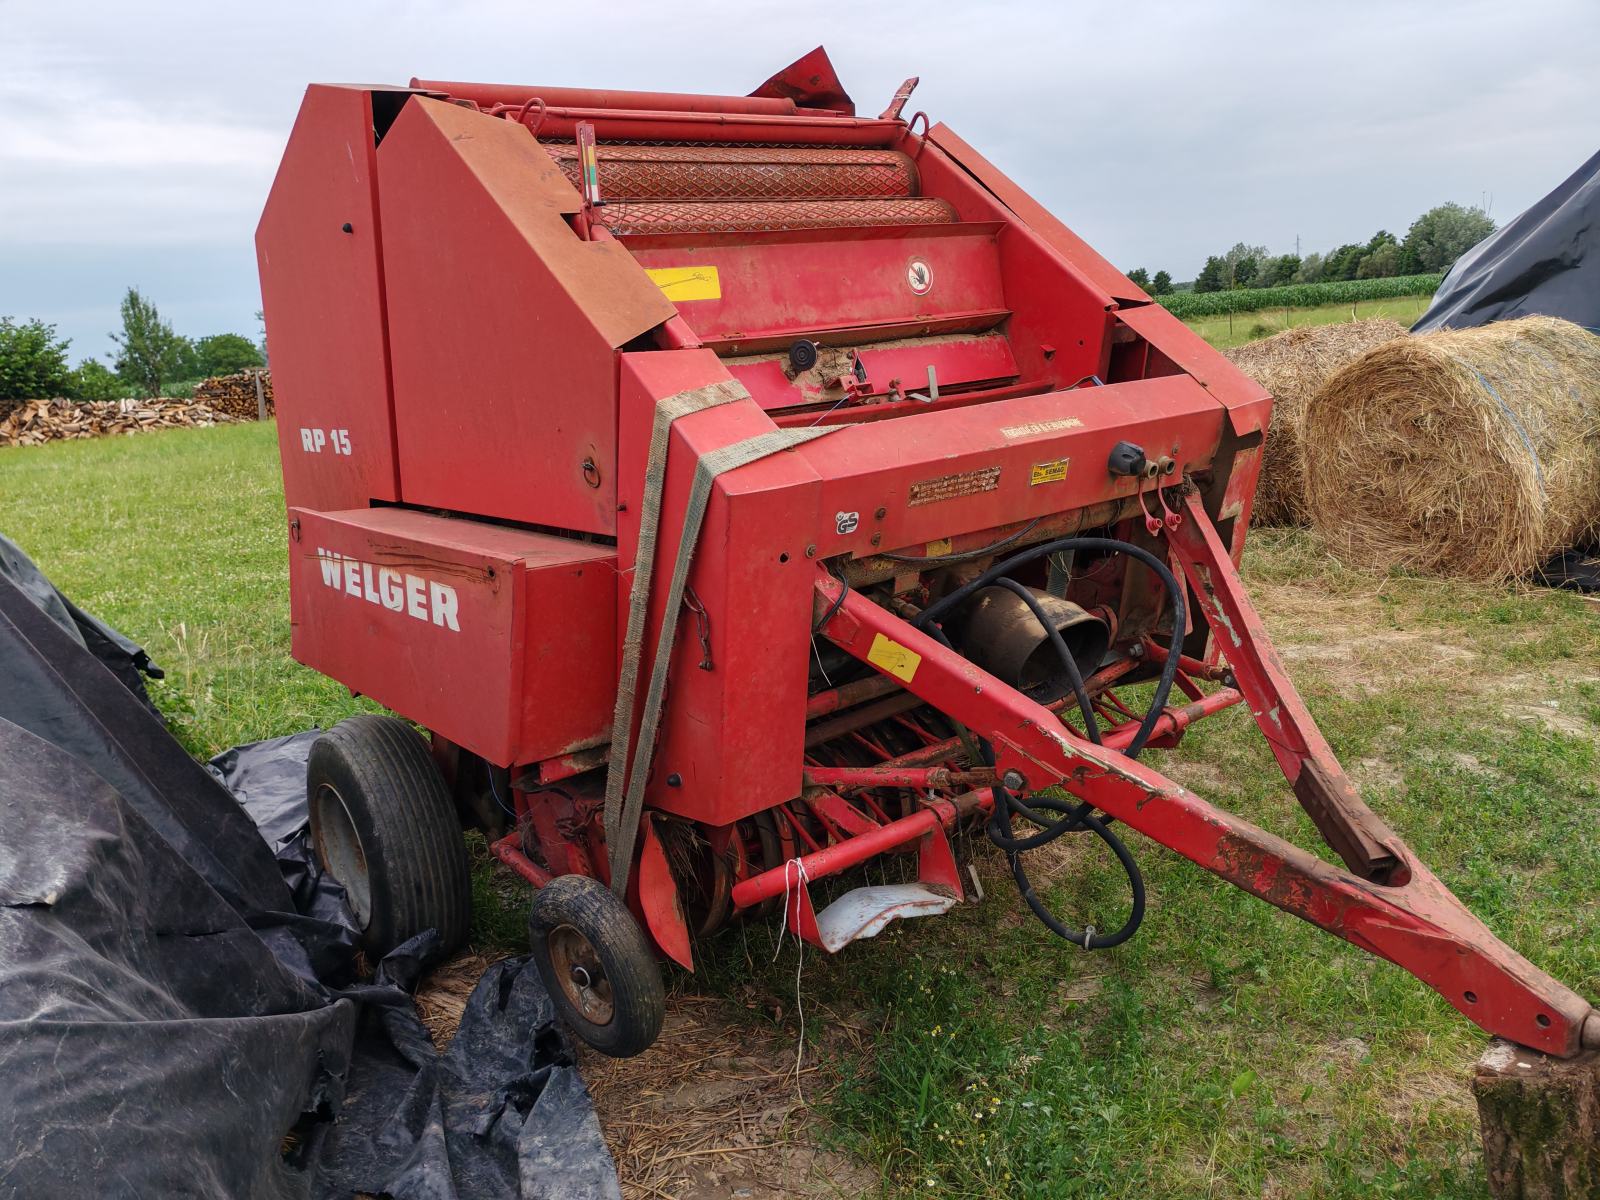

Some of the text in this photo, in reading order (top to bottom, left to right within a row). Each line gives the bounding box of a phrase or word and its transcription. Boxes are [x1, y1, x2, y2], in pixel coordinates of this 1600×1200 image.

[300, 428, 352, 456] RP 15
[317, 547, 461, 632] WELGER
